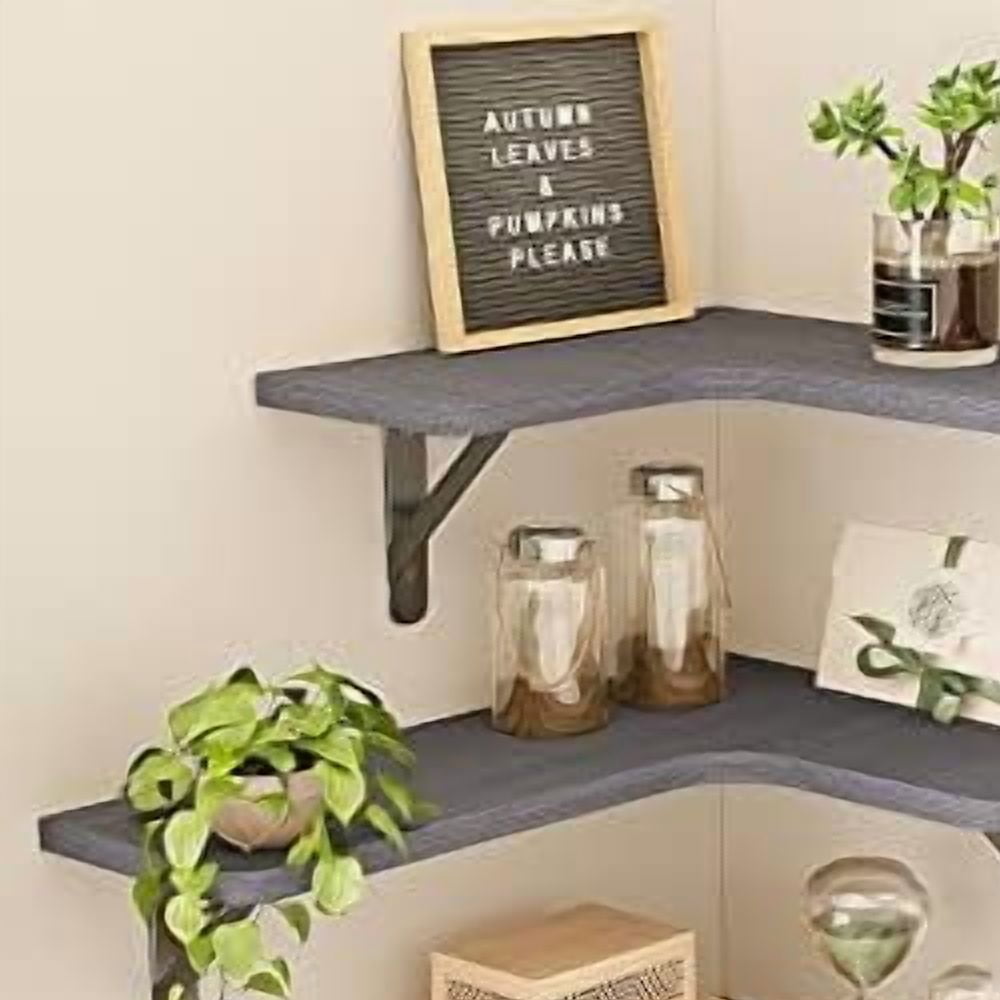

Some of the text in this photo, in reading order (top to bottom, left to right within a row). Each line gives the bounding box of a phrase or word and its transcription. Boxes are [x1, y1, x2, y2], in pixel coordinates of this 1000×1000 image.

[483, 103, 592, 133] AUTUMN
[490, 137, 594, 168] LEAVES
[486, 202, 624, 238] PUMPKINS
[510, 237, 608, 270] PLEASE
